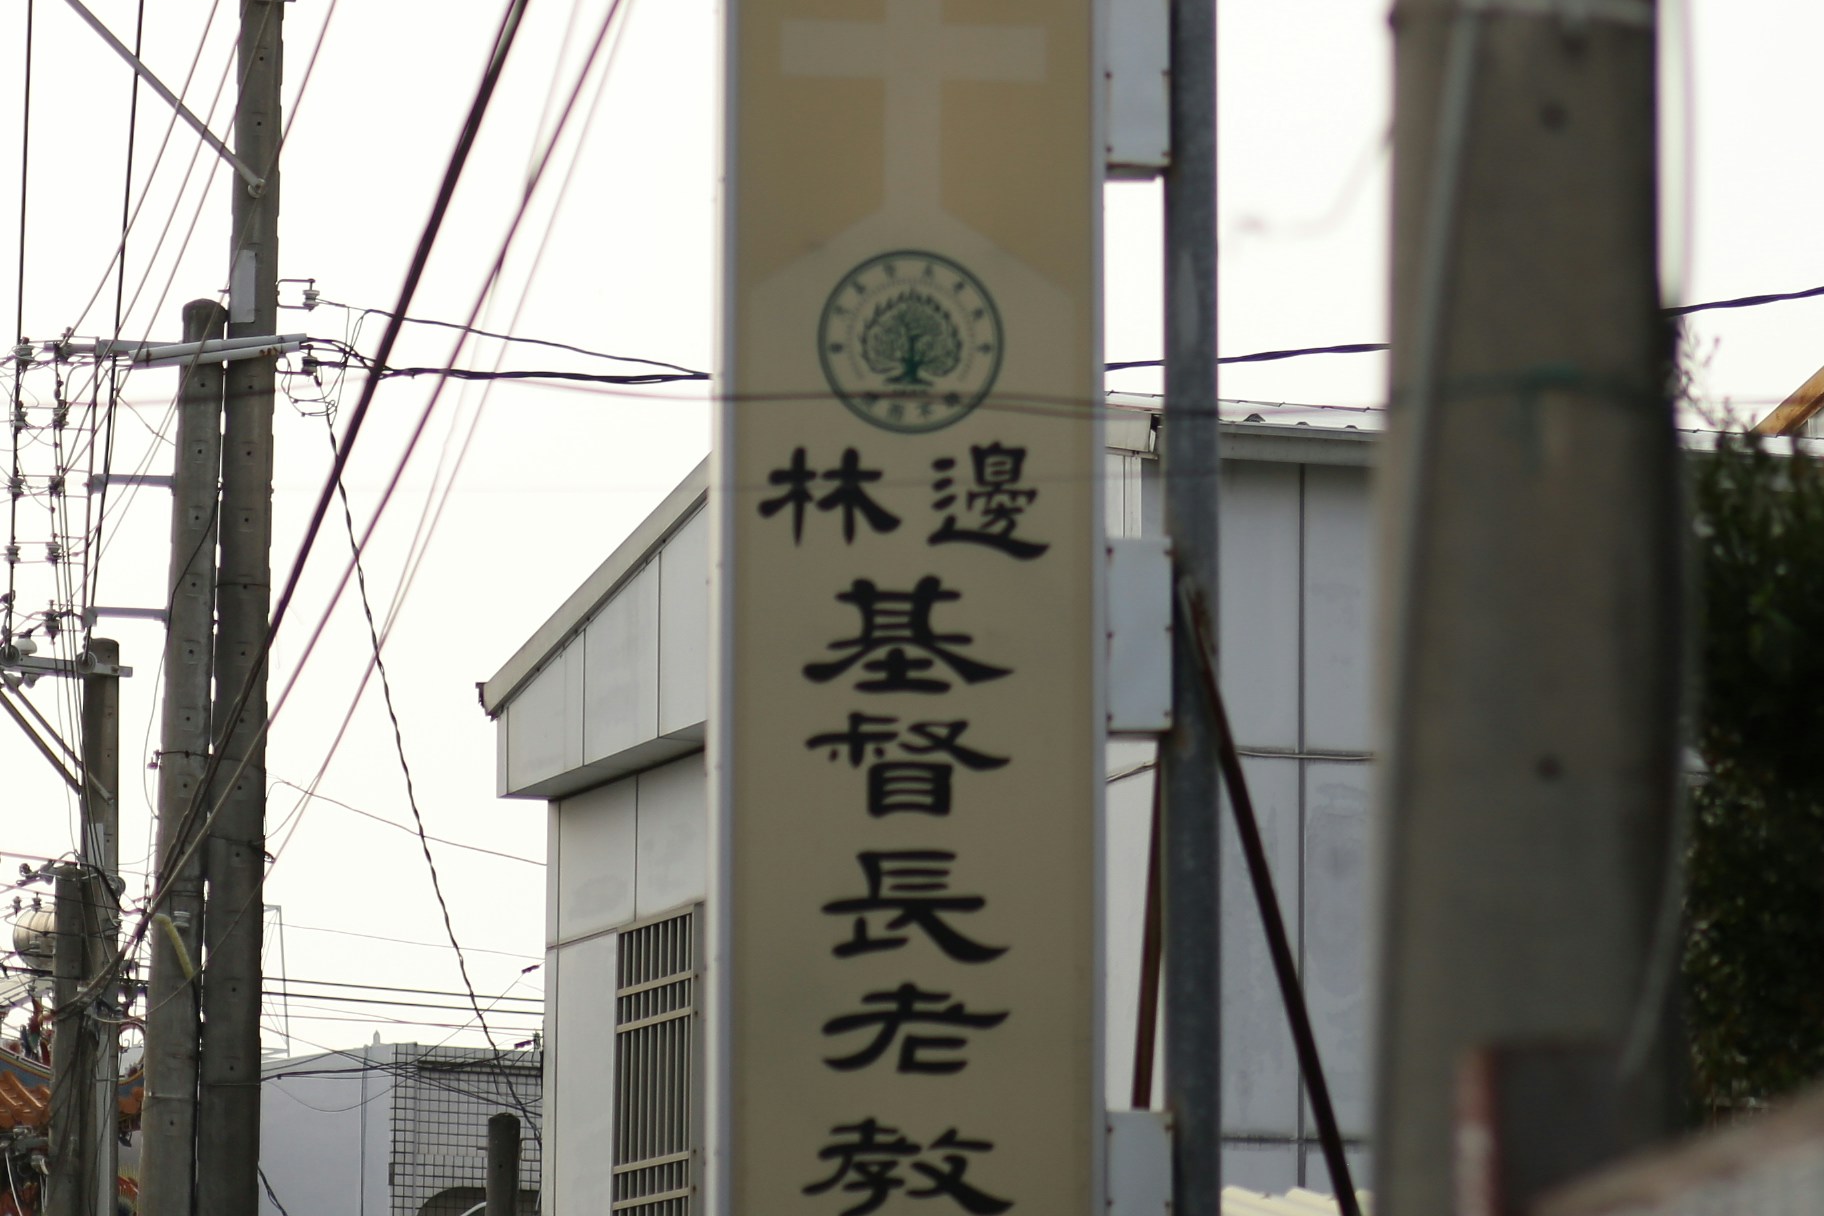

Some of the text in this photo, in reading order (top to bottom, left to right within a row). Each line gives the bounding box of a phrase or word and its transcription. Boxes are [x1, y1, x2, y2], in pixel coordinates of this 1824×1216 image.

[757, 440, 1050, 562] 林邊
[801, 574, 1015, 1216] 基督長老教
